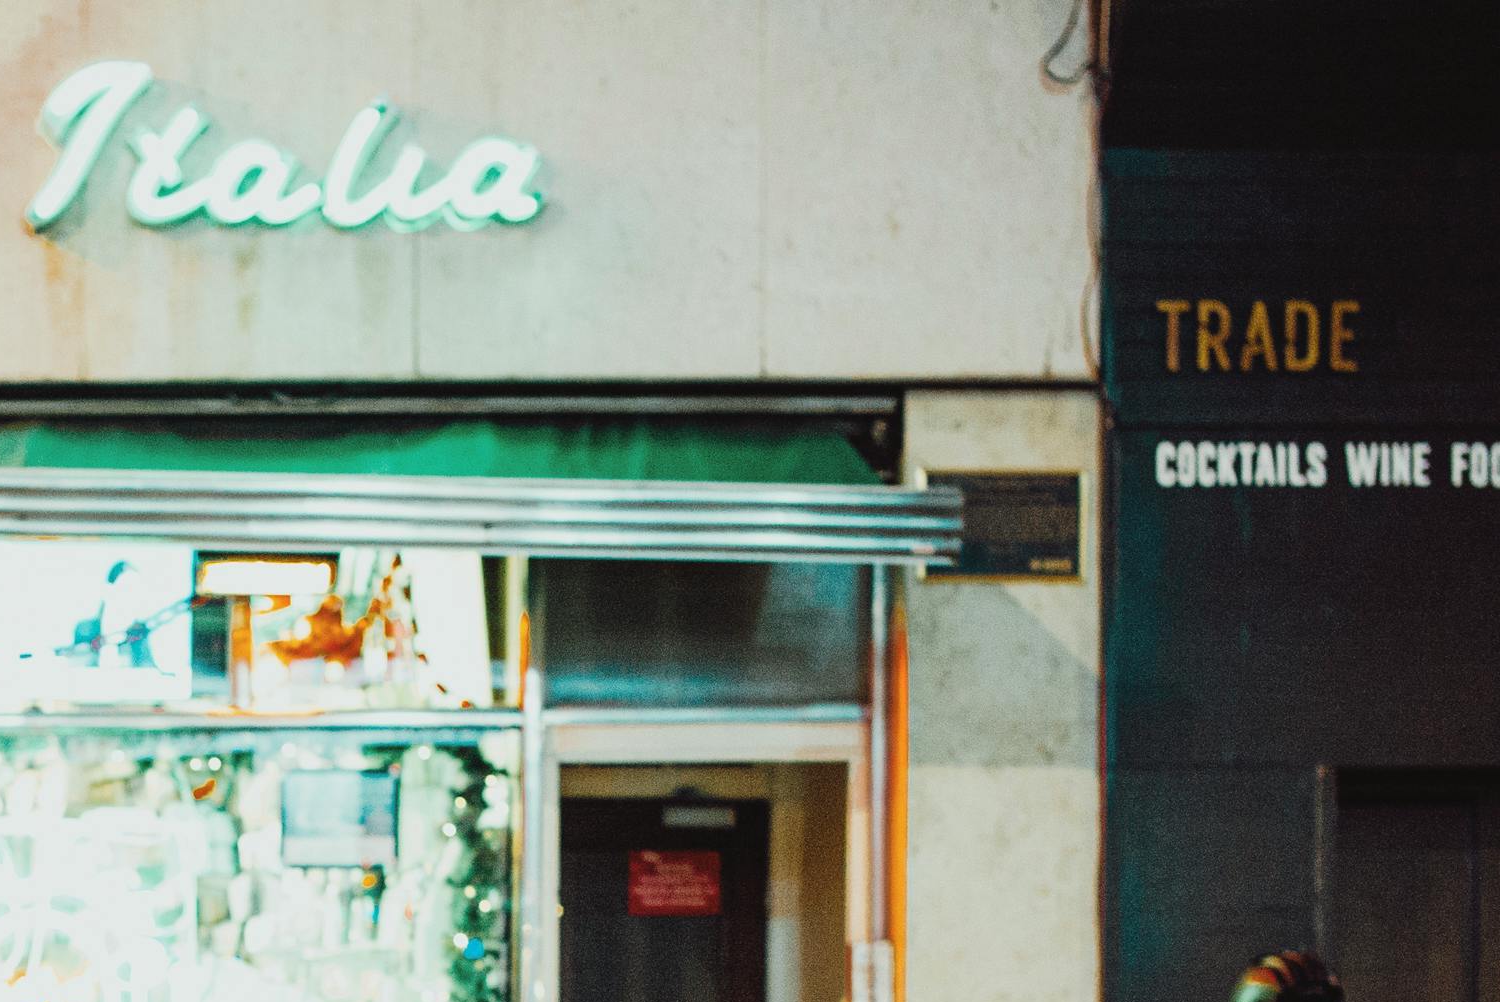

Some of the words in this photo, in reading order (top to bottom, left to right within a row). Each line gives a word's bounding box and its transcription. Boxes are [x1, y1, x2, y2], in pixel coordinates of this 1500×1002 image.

[26, 60, 542, 232] Italia
[1155, 298, 1362, 373] TRADE
[1155, 440, 1328, 488] COCKTAILS
[1344, 441, 1432, 488] WINE
